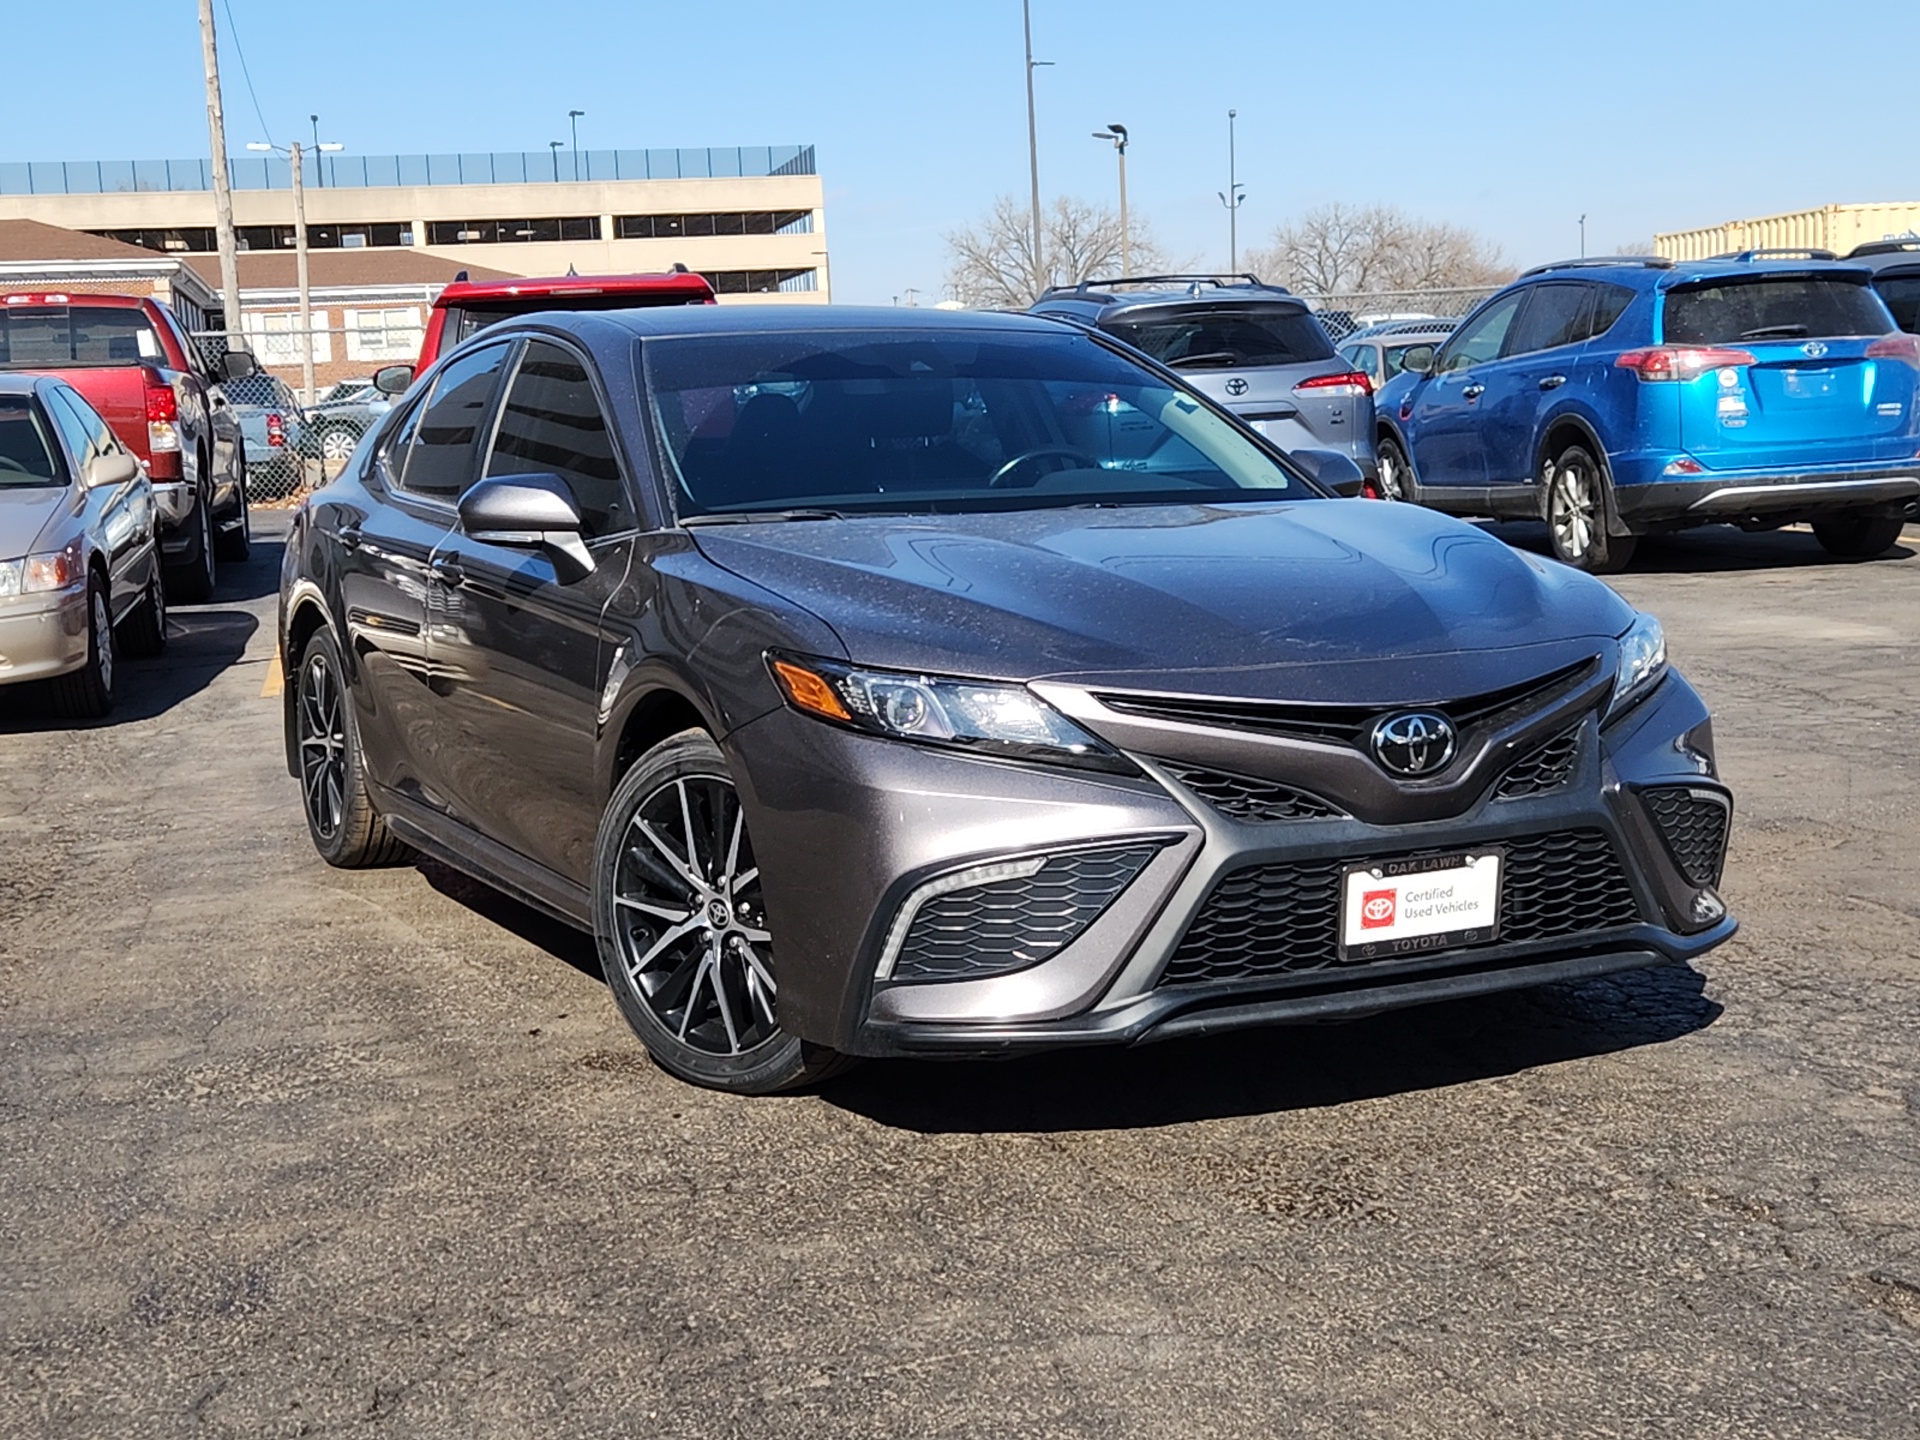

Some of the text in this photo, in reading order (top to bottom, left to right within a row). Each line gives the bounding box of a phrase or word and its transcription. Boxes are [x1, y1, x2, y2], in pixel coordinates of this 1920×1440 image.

[1388, 855, 1460, 874] OAK LAWN
[1405, 885, 1454, 903] Certified
[1404, 899, 1479, 919] Used Vehicles
[1392, 934, 1448, 952] TOYOTA
